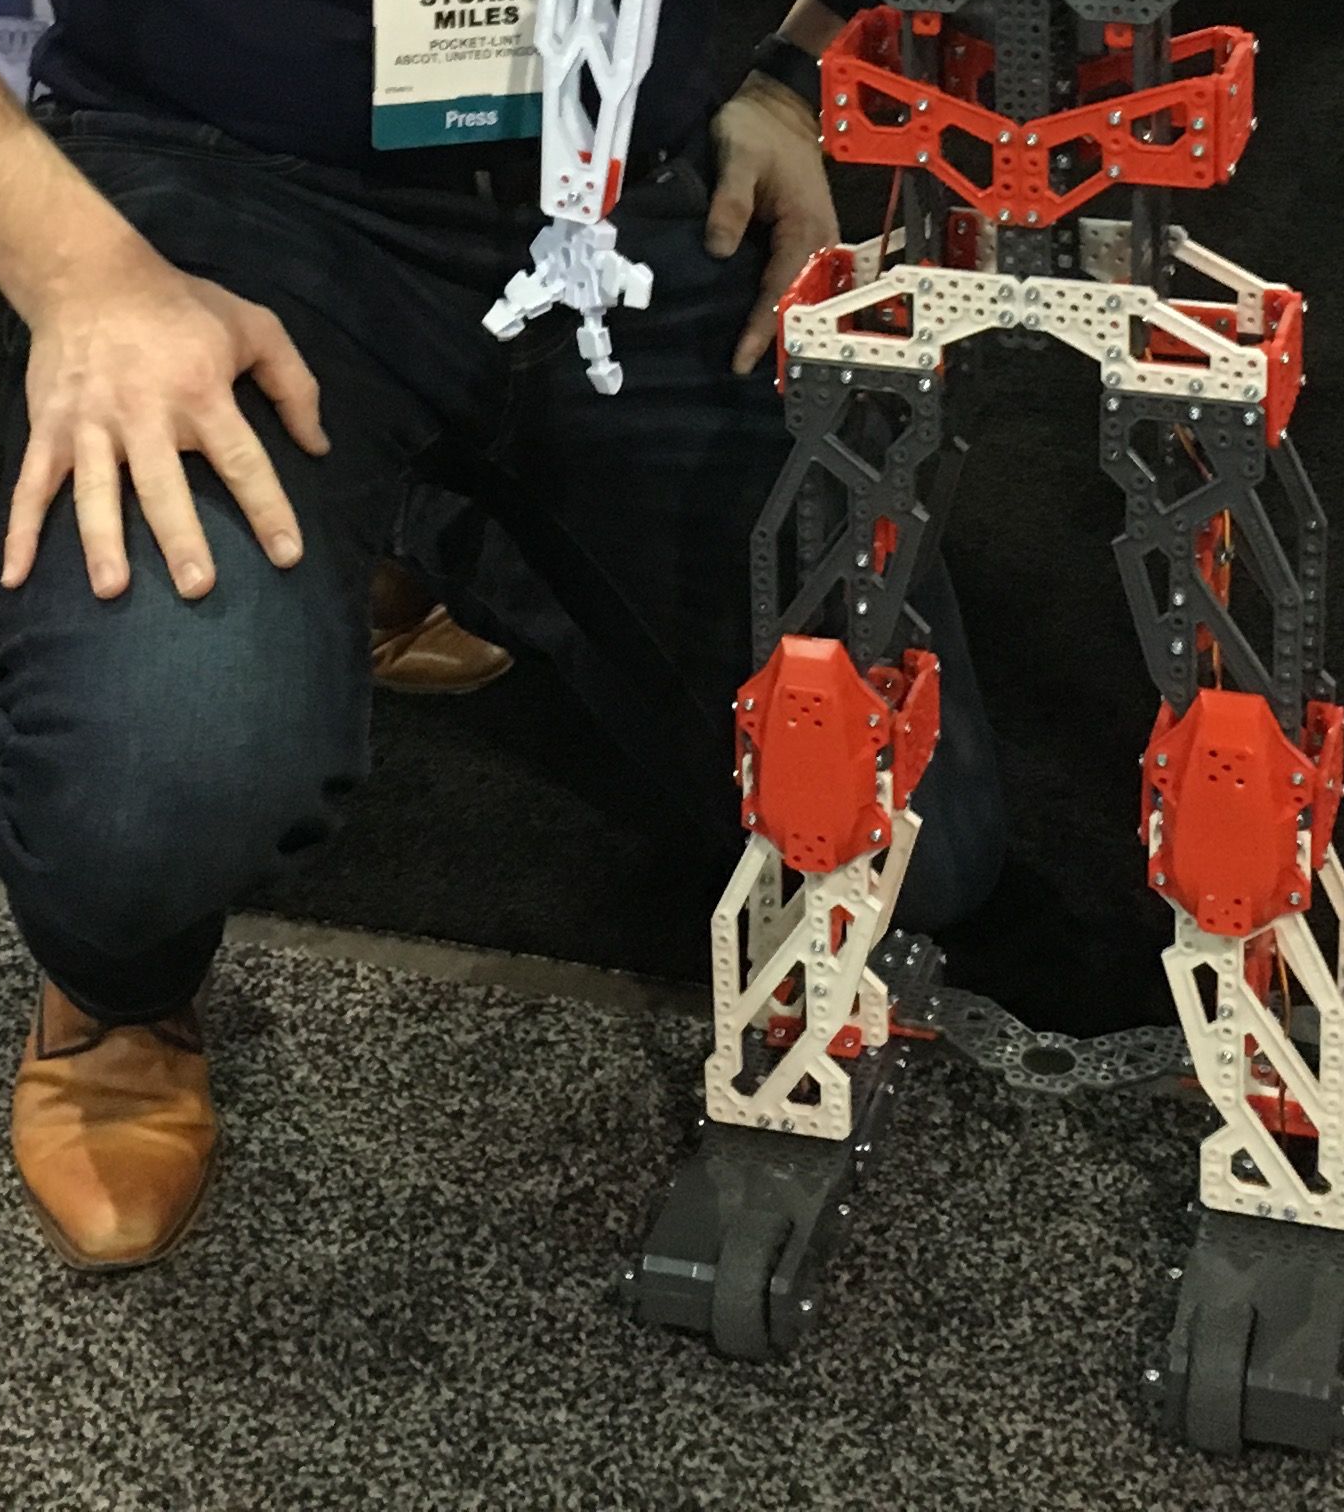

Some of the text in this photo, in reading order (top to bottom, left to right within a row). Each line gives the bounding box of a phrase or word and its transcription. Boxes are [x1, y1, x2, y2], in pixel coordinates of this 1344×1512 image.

[434, 6, 520, 30] MILES
[429, 34, 523, 51] POCKET-LINT
[394, 53, 442, 66] ASCOT,
[444, 49, 492, 63] UNITED
[444, 110, 499, 129] Press
